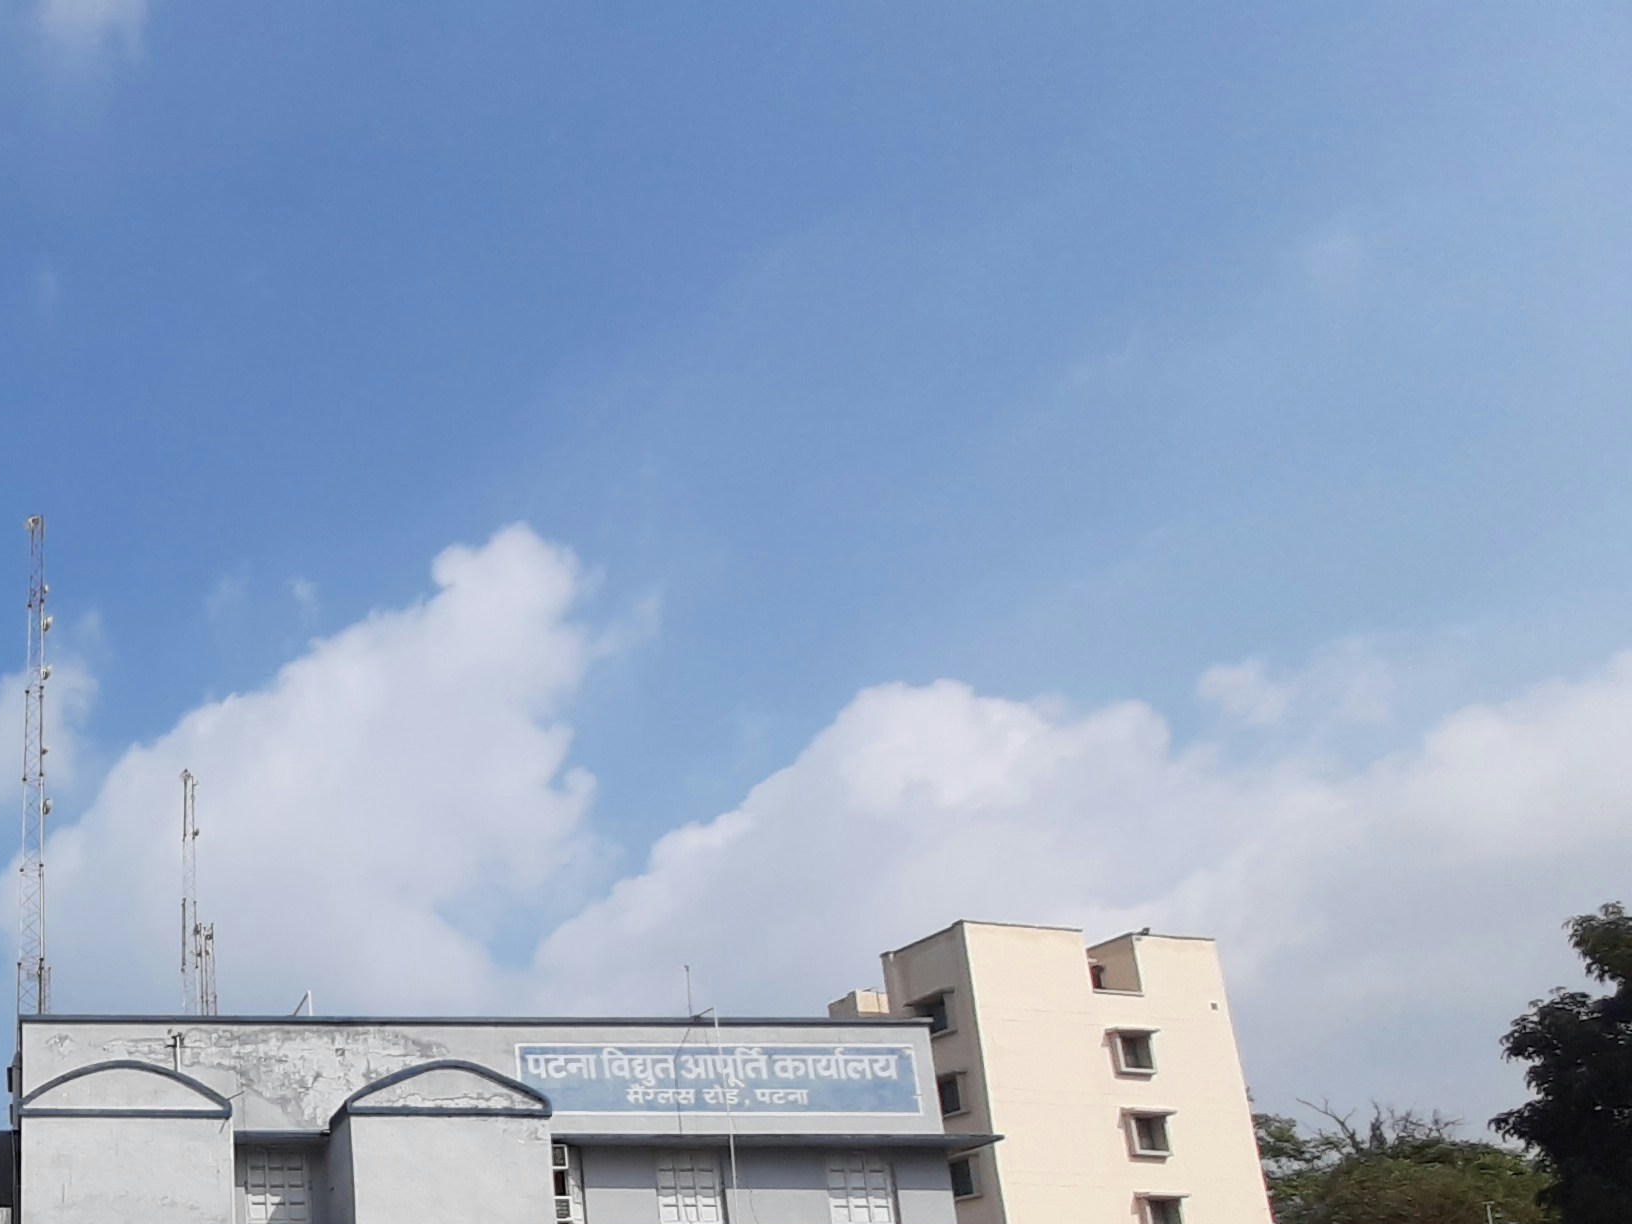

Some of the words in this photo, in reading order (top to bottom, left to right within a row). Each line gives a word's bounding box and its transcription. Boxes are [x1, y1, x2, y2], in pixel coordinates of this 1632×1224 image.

[525, 1054, 597, 1080] पटना
[600, 1047, 675, 1088] विद्युत
[680, 1047, 768, 1087] आपूर्ति
[771, 1046, 899, 1080] कार्यालय
[753, 1088, 809, 1105] पटना
